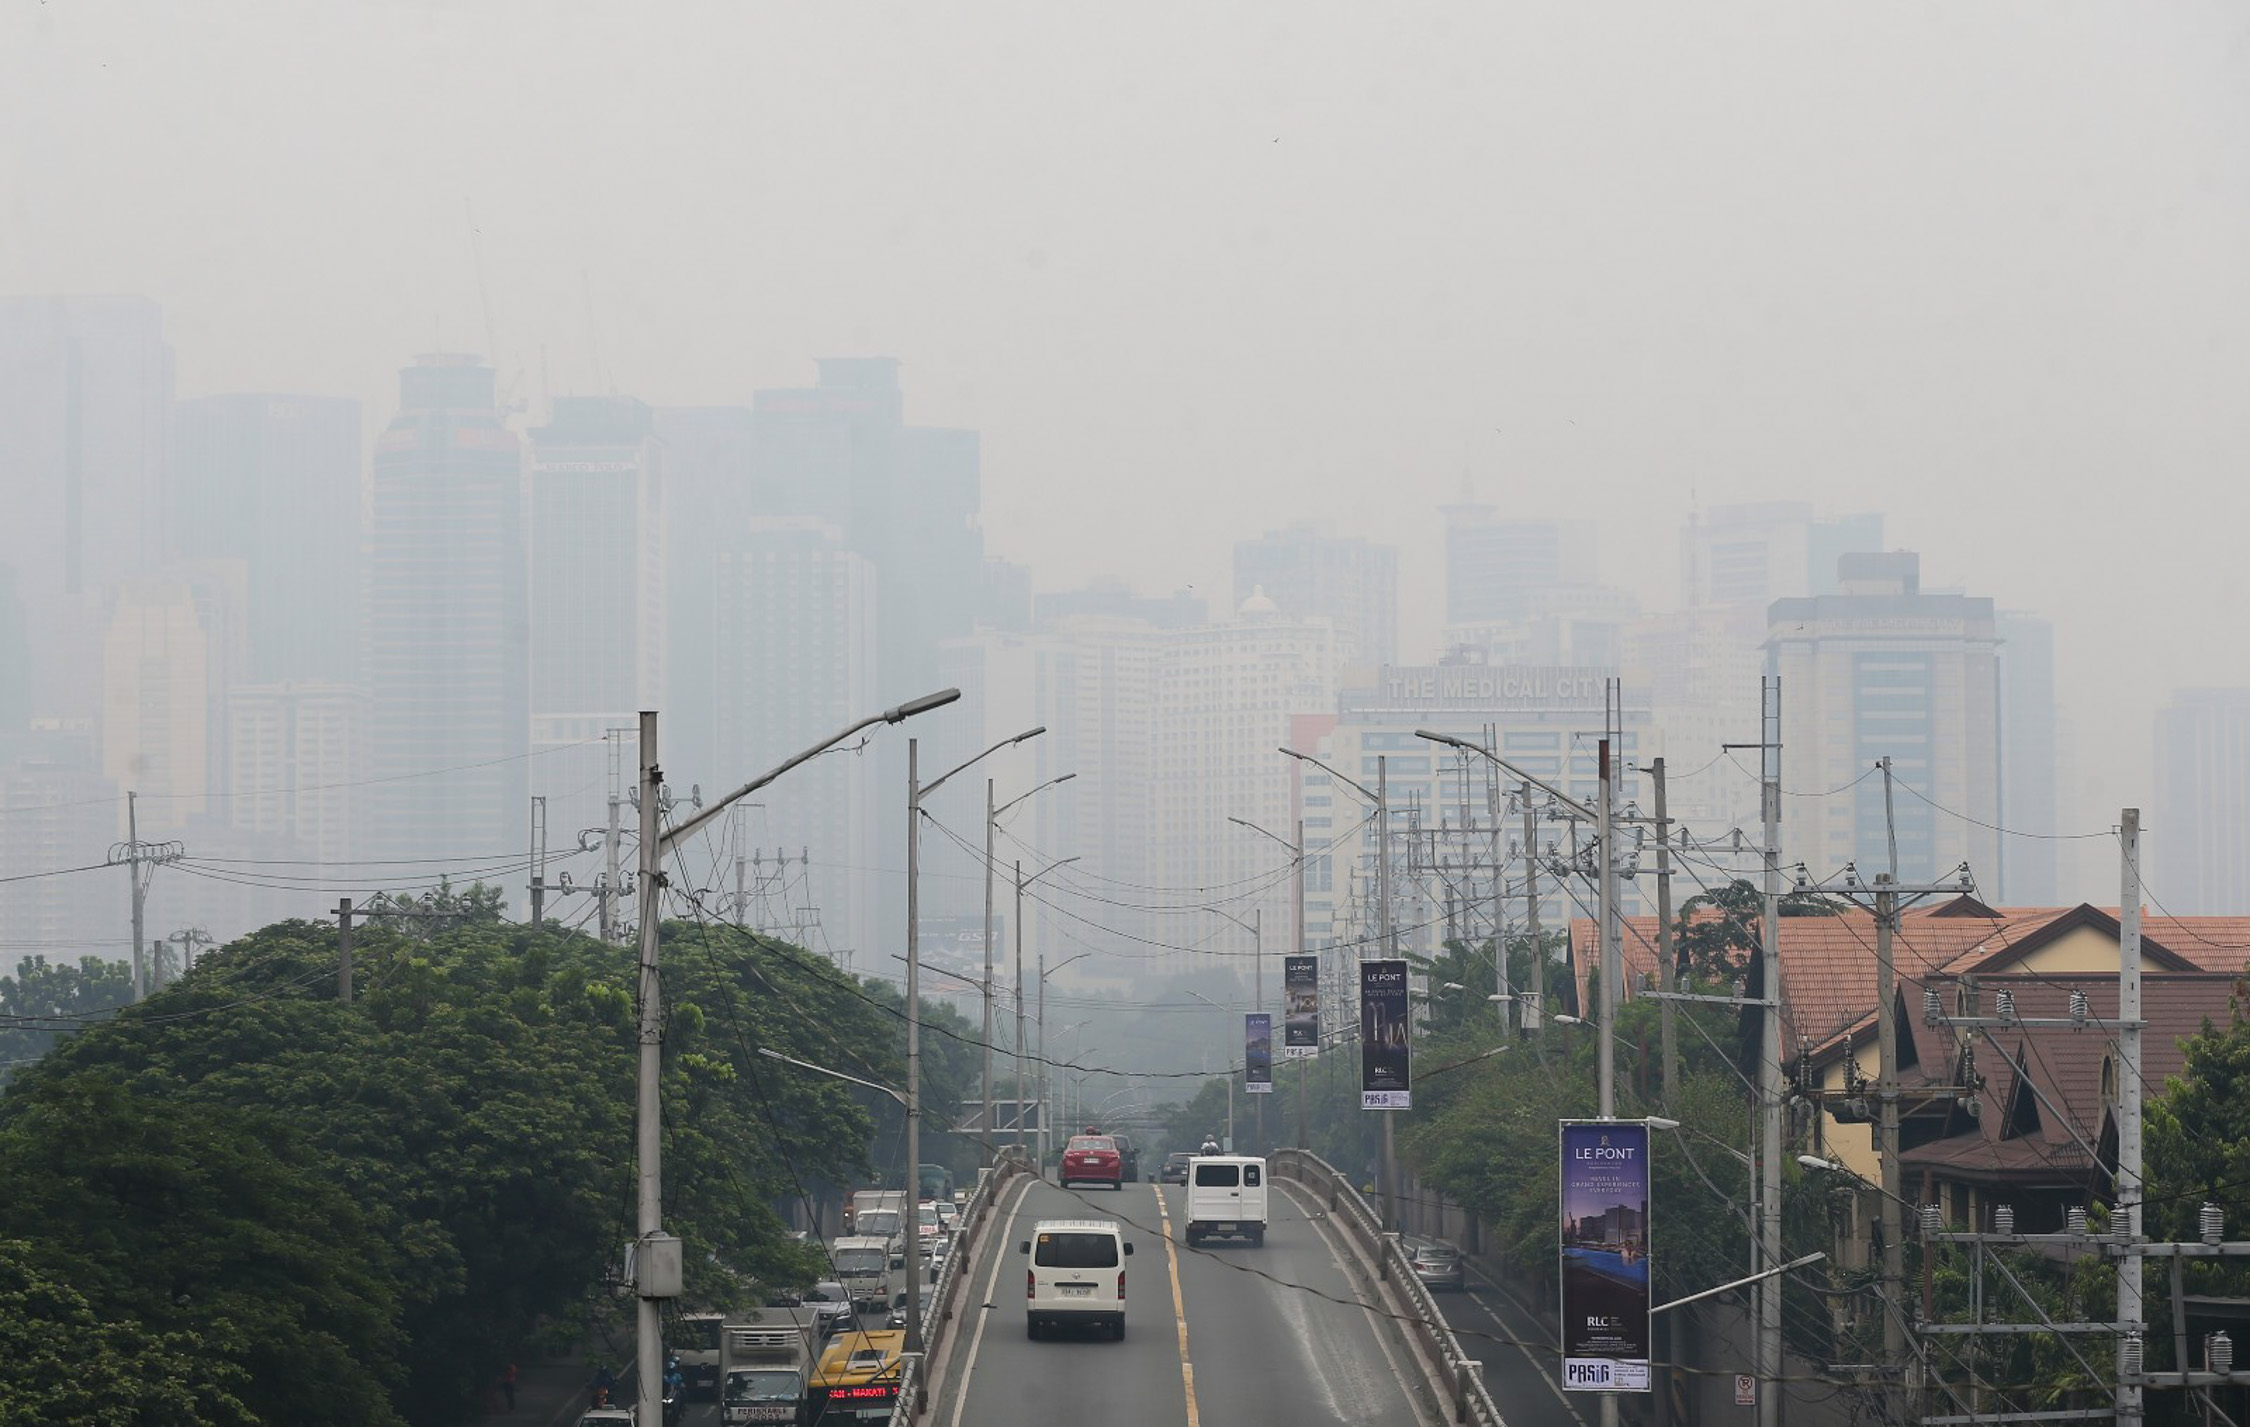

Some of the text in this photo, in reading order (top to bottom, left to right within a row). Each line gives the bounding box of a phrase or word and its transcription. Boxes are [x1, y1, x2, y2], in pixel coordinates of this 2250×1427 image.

[1387, 679, 1610, 698] THE MEDICAL CITY
[1575, 1148, 1635, 1159] LE PONT
[1587, 1316, 1609, 1326] RLC
[852, 1388, 886, 1397] MAKATI
